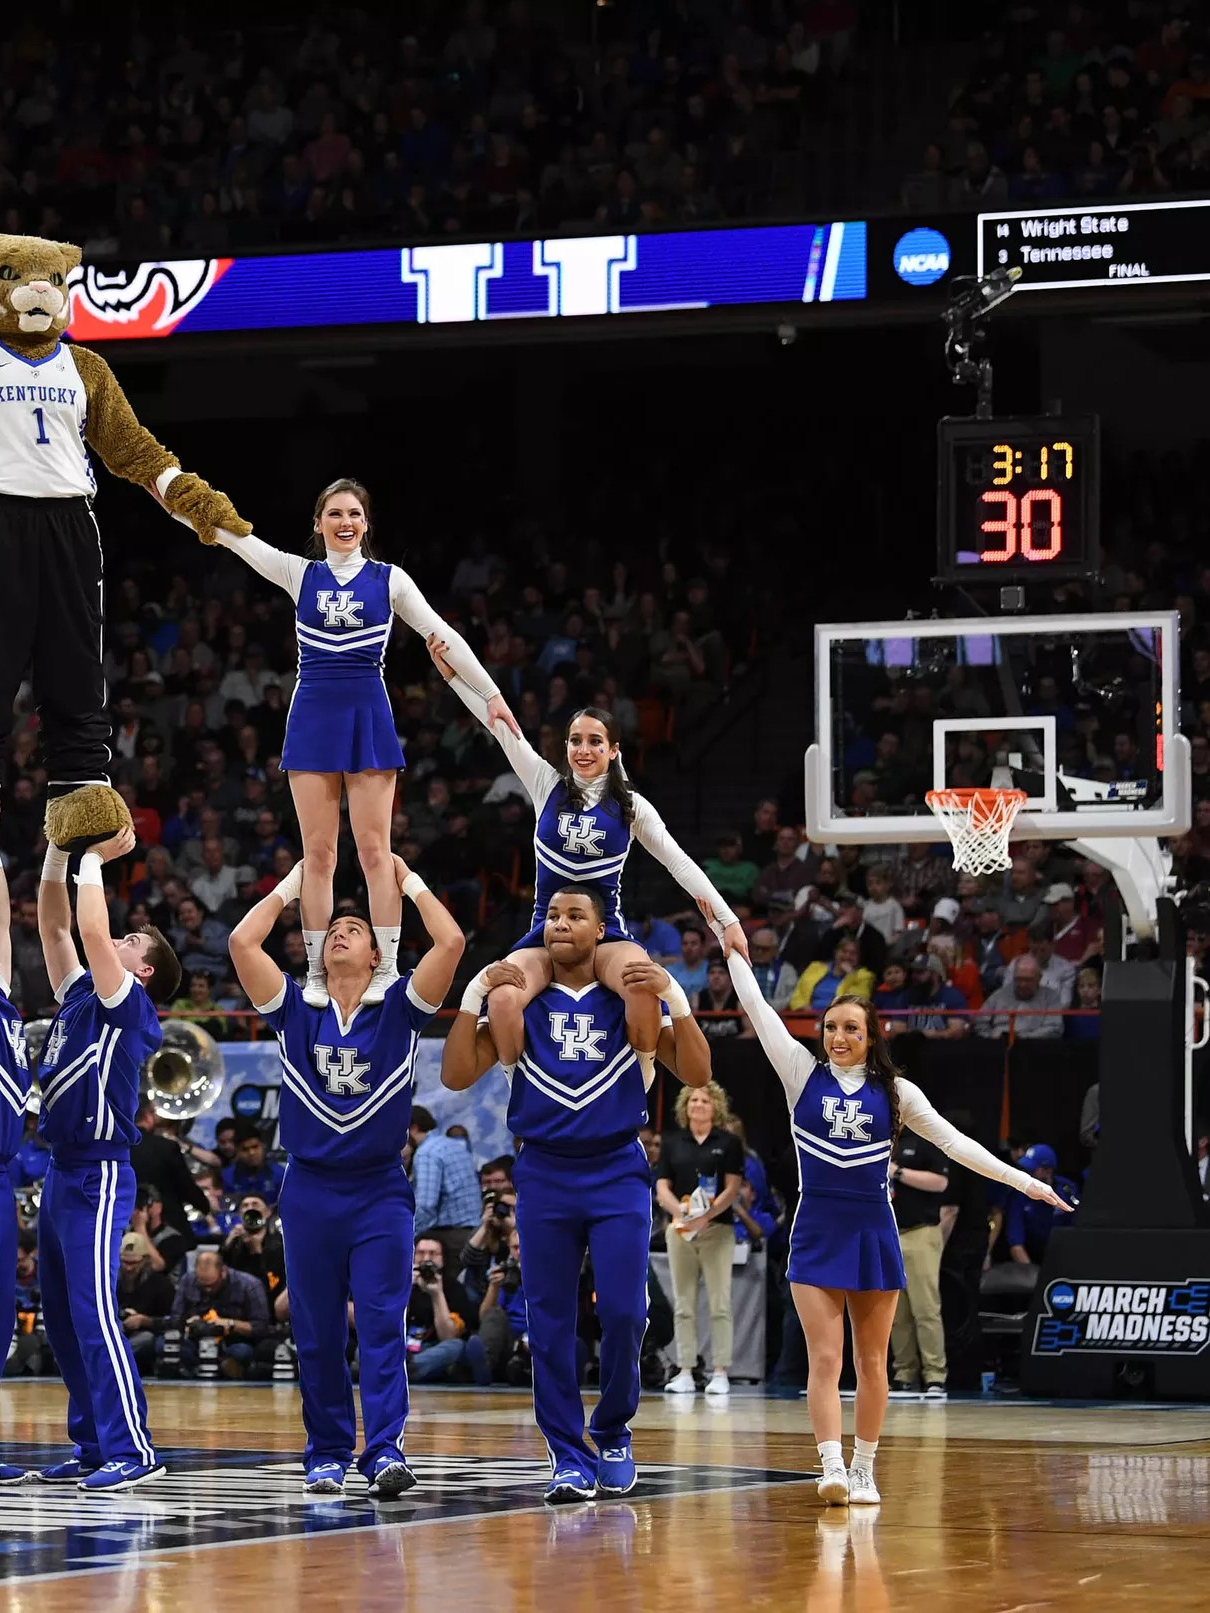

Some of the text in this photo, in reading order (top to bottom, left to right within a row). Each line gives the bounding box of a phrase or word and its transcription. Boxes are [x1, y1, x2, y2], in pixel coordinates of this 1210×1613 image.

[1020, 218, 1078, 239] Wright
[1080, 215, 1129, 234] State
[898, 252, 949, 274] NCAA
[1019, 243, 1114, 264] Tennessee
[1109, 262, 1150, 278] FINAL
[32, 407, 50, 444] 1
[992, 442, 1073, 485] 3:17
[980, 489, 1062, 562] 30
[316, 590, 364, 628] UK
[557, 812, 607, 857] UK
[549, 1012, 607, 1062] UK
[314, 1044, 372, 1095] UK
[821, 1096, 873, 1142] UK
[1075, 1286, 1168, 1314] MARCH
[1085, 1314, 1209, 1342] MADNESS
